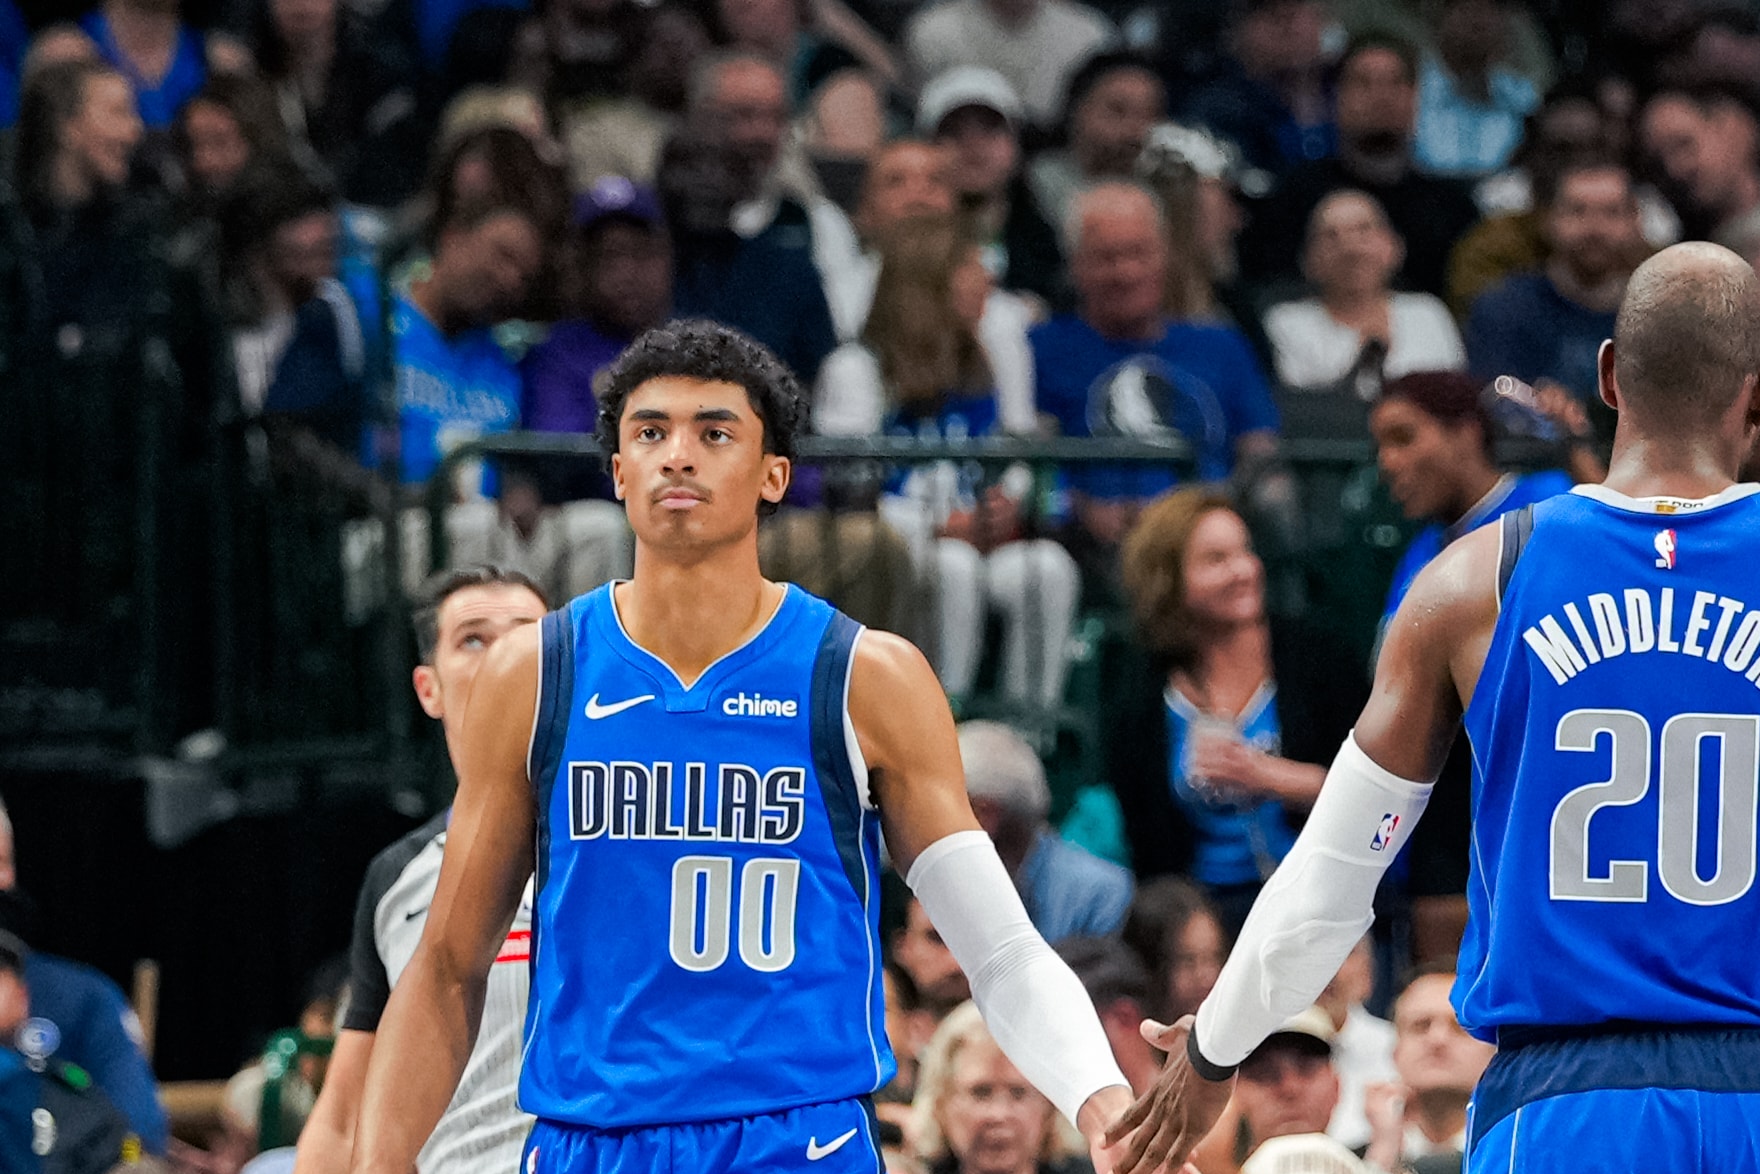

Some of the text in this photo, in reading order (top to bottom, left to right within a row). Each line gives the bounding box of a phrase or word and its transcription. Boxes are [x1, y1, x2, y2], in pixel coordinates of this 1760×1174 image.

[722, 692, 798, 718] chime
[568, 761, 805, 844] DALLAS
[1549, 708, 1760, 906] 20
[669, 855, 800, 972] 00
